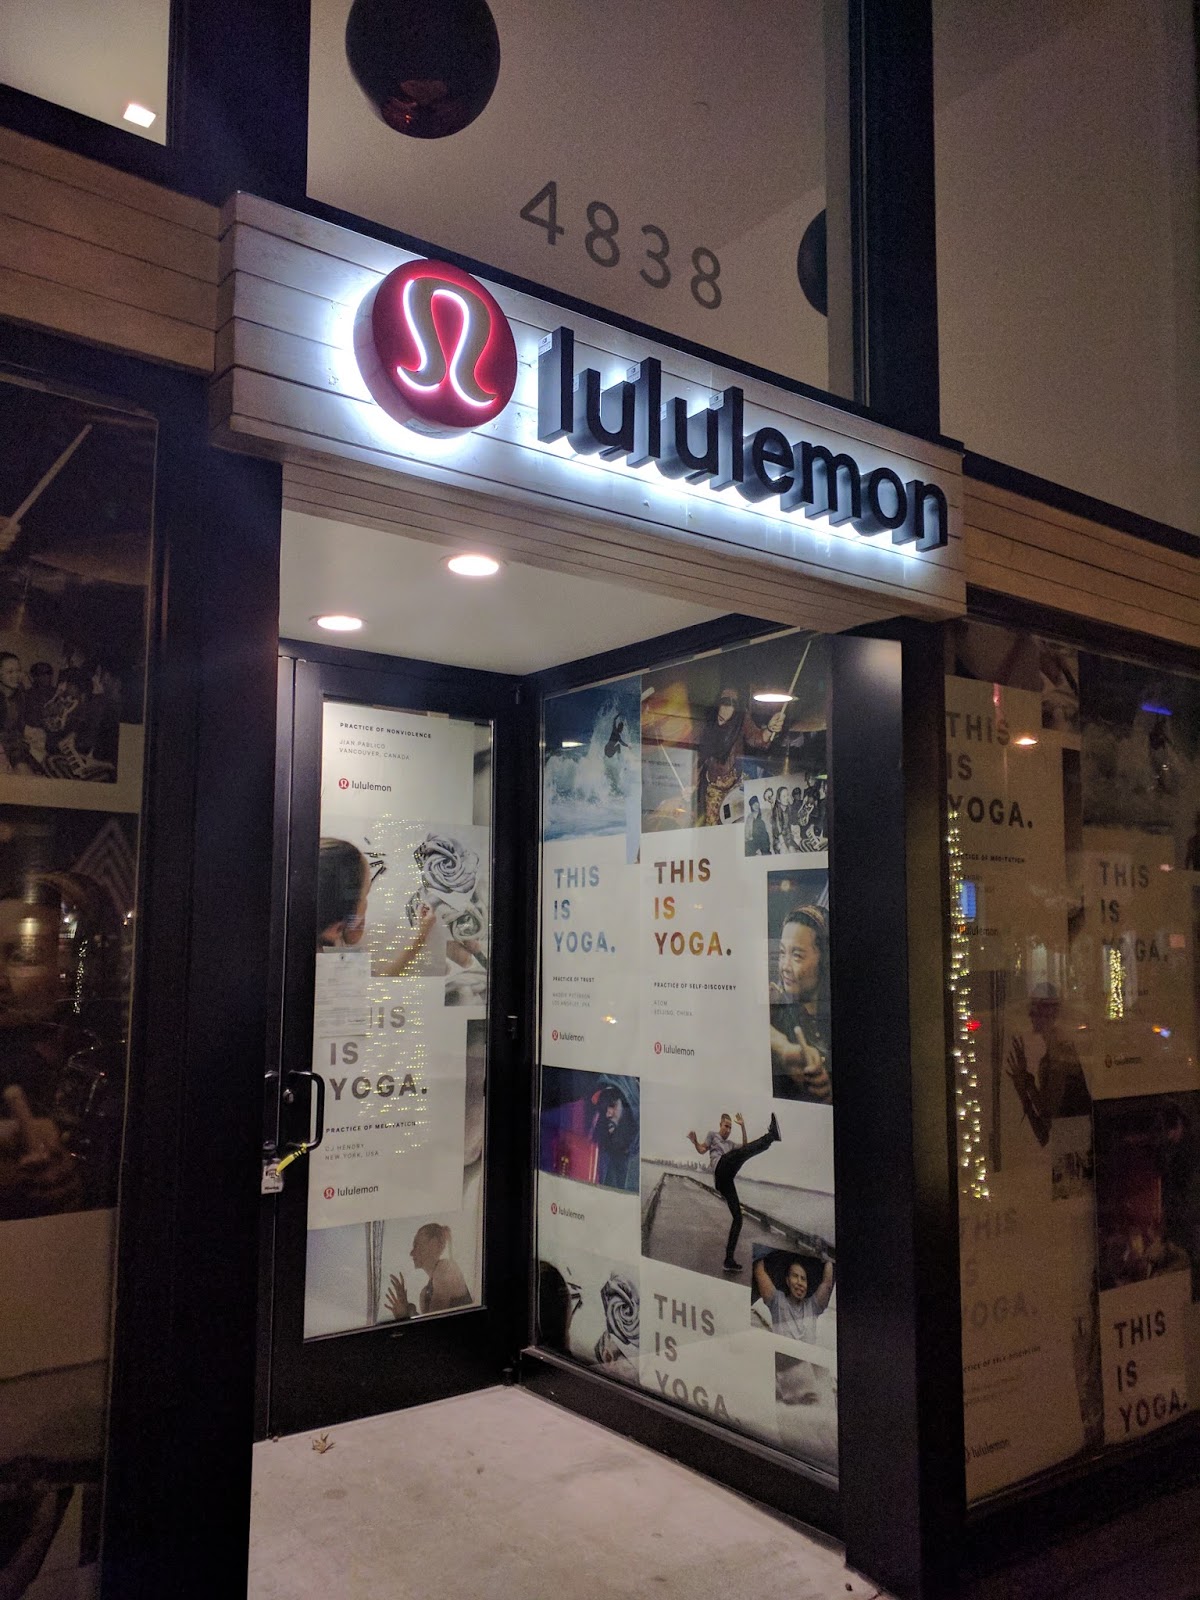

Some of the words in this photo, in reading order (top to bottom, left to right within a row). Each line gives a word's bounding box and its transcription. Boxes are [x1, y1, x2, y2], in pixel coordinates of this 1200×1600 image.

[519, 180, 723, 311] 4838
[538, 325, 948, 552] lululemon
[340, 722, 374, 732] PRACTICE
[386, 728, 432, 739] NONVIOLENCE
[946, 711, 1011, 746] THIS
[383, 752, 410, 760] CANADA
[947, 753, 972, 781] IS
[351, 780, 392, 793] lululemon
[947, 793, 1033, 829] YOGA.
[554, 865, 600, 889] THIS
[654, 858, 711, 884] THIS
[1099, 861, 1149, 889] THIS
[554, 899, 571, 921] IS
[654, 896, 676, 920] IS
[1101, 899, 1119, 923] IS
[553, 931, 616, 953] YOGA.
[654, 931, 732, 956] YOGA.
[559, 1032, 585, 1042] lululemon
[330, 1042, 359, 1066] IS
[663, 1043, 695, 1056] lululemon
[328, 1073, 428, 1101] YOGA.
[325, 1126, 361, 1134] PRACTICE
[337, 1184, 379, 1197] lululemon
[654, 1293, 715, 1336] THIS
[1113, 1310, 1166, 1349] THIS
[654, 1332, 678, 1362] IS
[1116, 1360, 1138, 1392] IS
